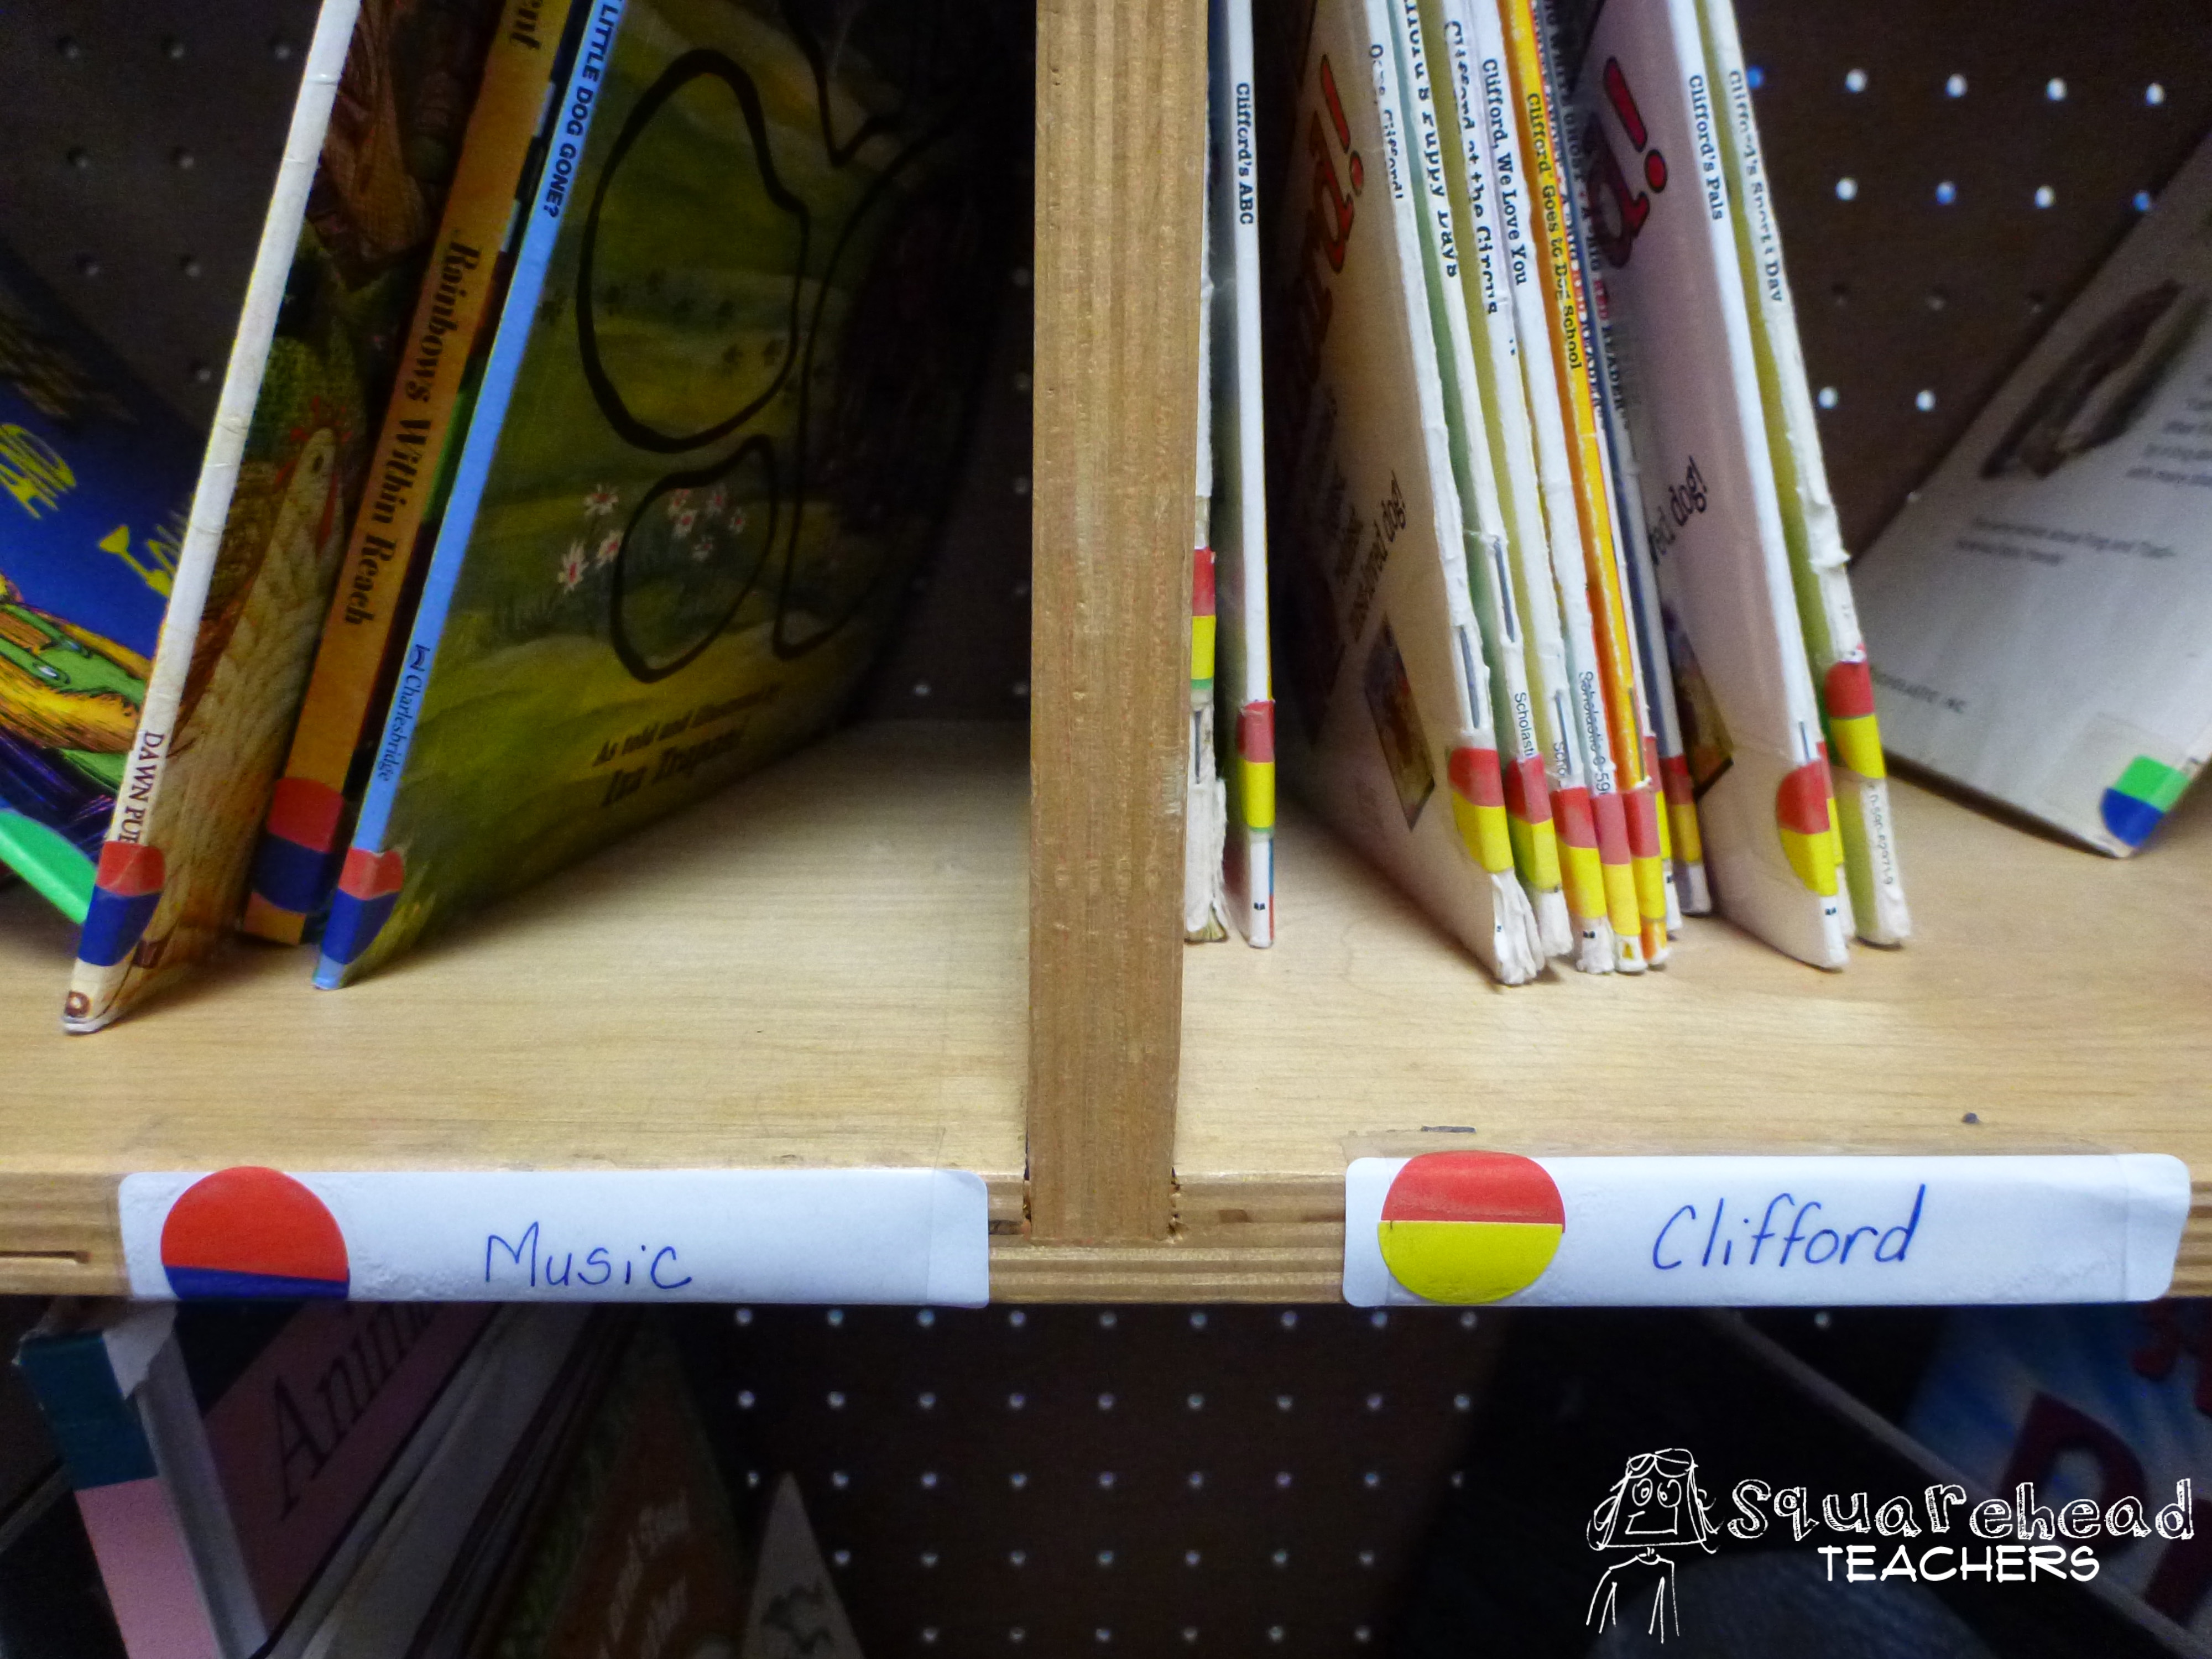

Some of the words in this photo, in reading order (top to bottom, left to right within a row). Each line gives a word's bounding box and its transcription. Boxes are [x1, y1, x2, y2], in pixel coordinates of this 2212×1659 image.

[583, 4, 619, 82] LITTLE
[566, 87, 594, 137] DOG
[1236, 82, 1253, 178] Clifford's
[1482, 57, 1509, 149] Clifford,
[543, 143, 577, 218] GONE?
[1496, 151, 1514, 186] We
[1689, 74, 1716, 172] Clifford's
[1707, 176, 1724, 221] Pals
[1239, 181, 1254, 225] ABC
[1502, 189, 1520, 241] Love
[1527, 92, 1553, 173] Clifford
[1542, 184, 1559, 233] Goes
[1563, 305, 1582, 369] School
[1510, 243, 1527, 286] You
[405, 241, 481, 403] Rainbows
[372, 419, 431, 524] Within
[345, 534, 397, 625] Reach
[129, 729, 165, 803] DAWN
[378, 674, 422, 781] Charlesbridge
[484, 1220, 692, 1290] Music
[1652, 1183, 1927, 1270] Clifford
